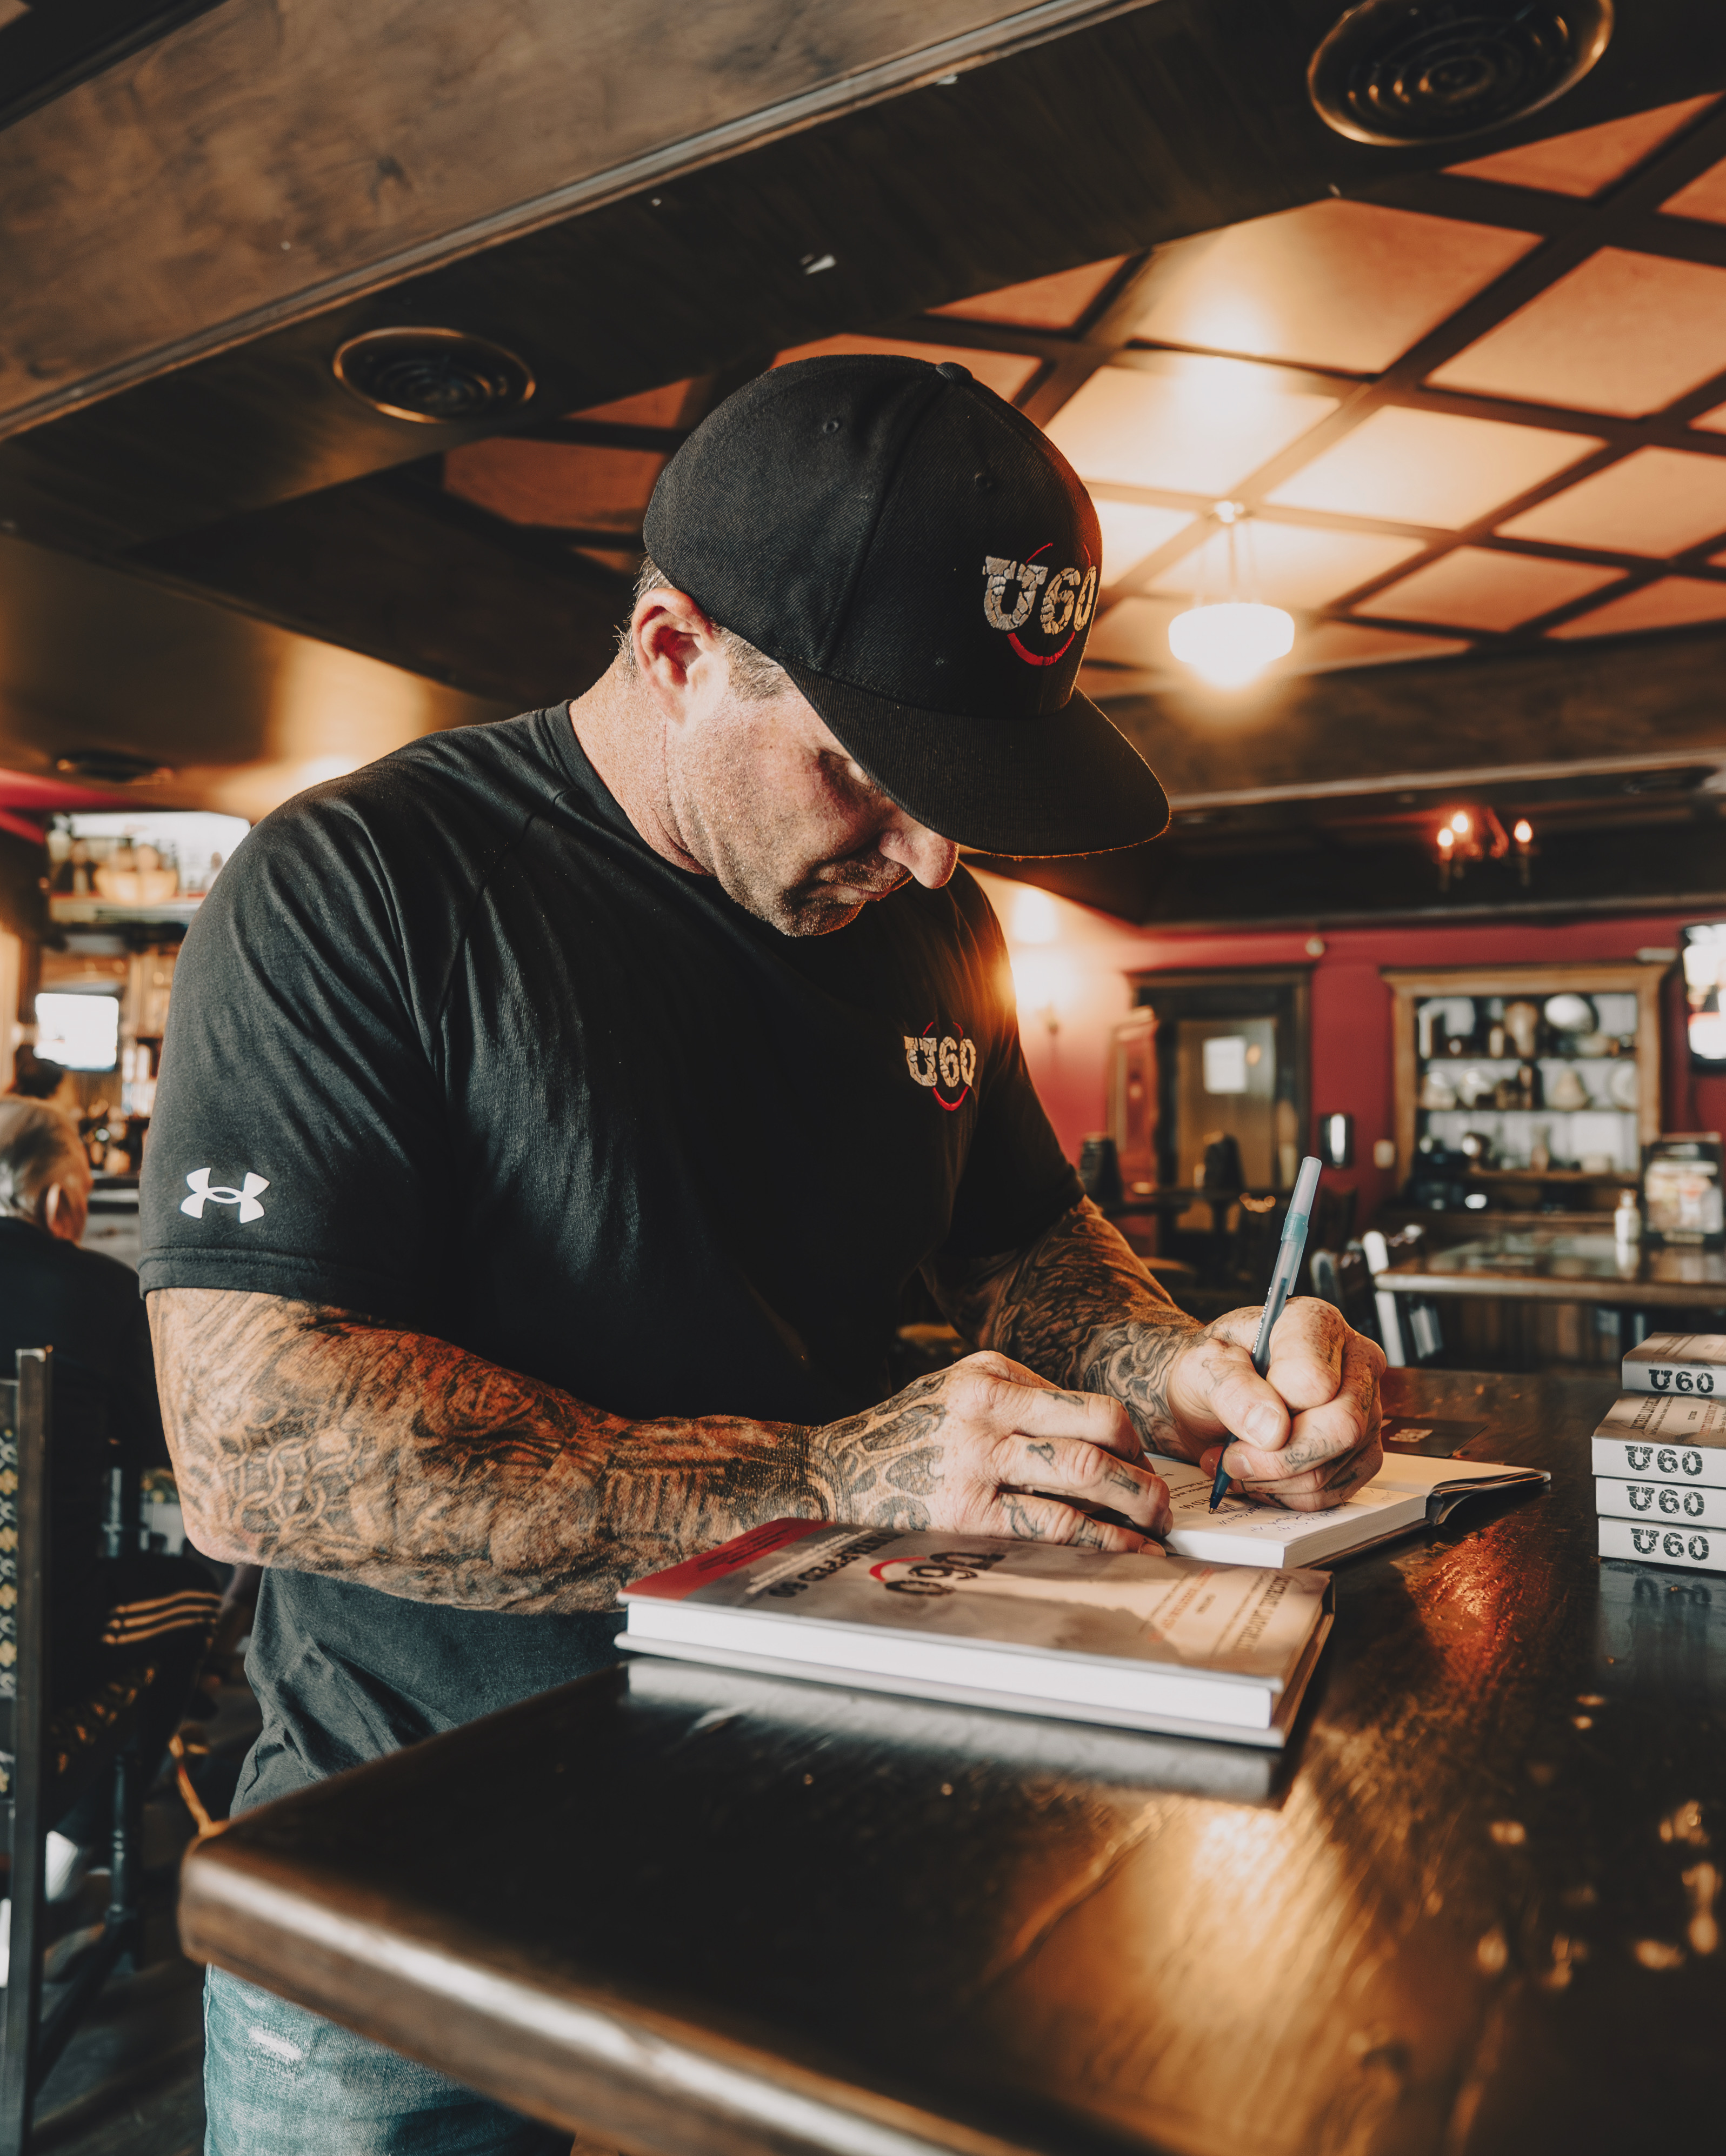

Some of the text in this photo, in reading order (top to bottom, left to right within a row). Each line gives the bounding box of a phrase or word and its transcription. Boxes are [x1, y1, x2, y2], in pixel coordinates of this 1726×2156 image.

[1649, 1369, 1714, 1393] U60
[1624, 1445, 1703, 1476] U60
[1626, 1485, 1705, 1517] U60
[1630, 1528, 1709, 1561] U60
